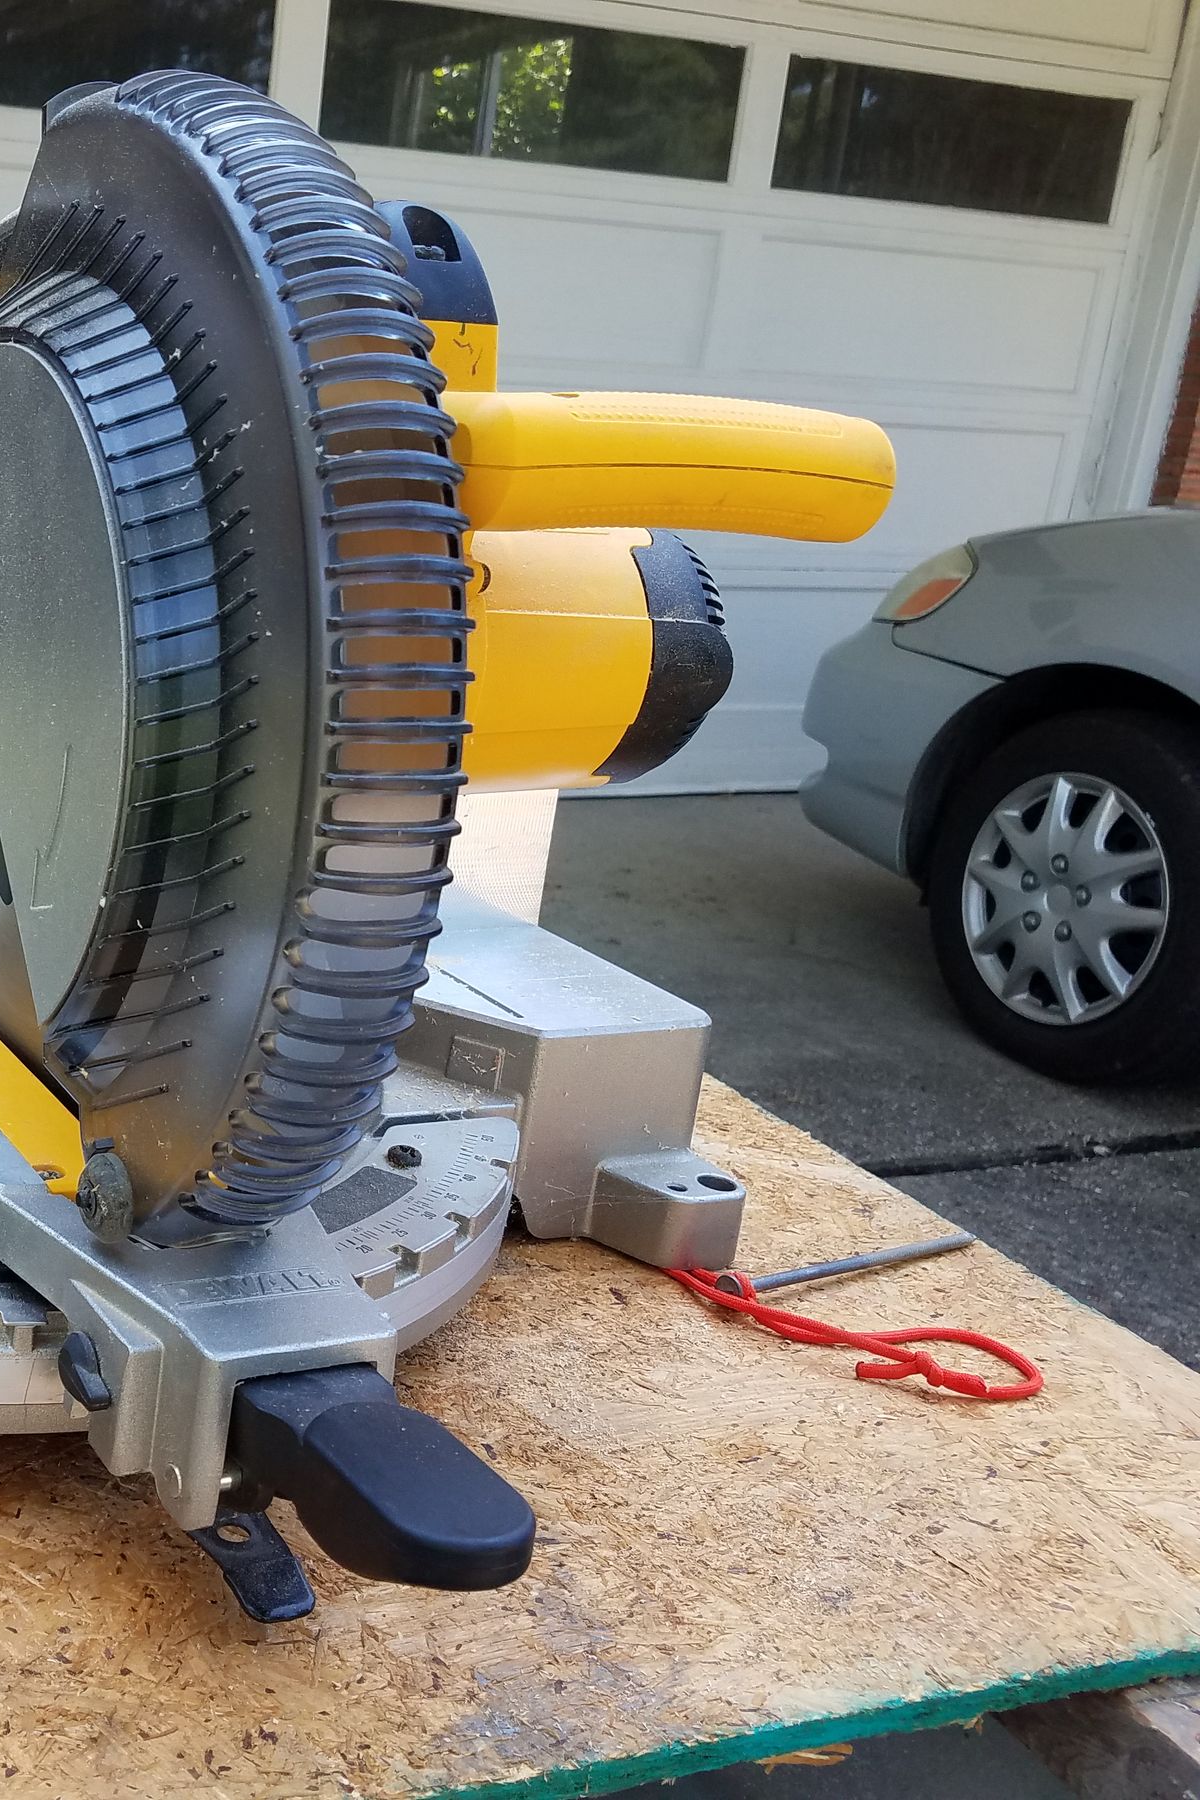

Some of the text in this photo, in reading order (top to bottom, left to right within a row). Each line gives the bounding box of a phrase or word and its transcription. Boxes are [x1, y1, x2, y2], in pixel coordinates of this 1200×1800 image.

[443, 1192, 460, 1202] 35
[421, 1211, 438, 1220] 30
[391, 1228, 409, 1238] 25
[355, 1244, 374, 1254] 20
